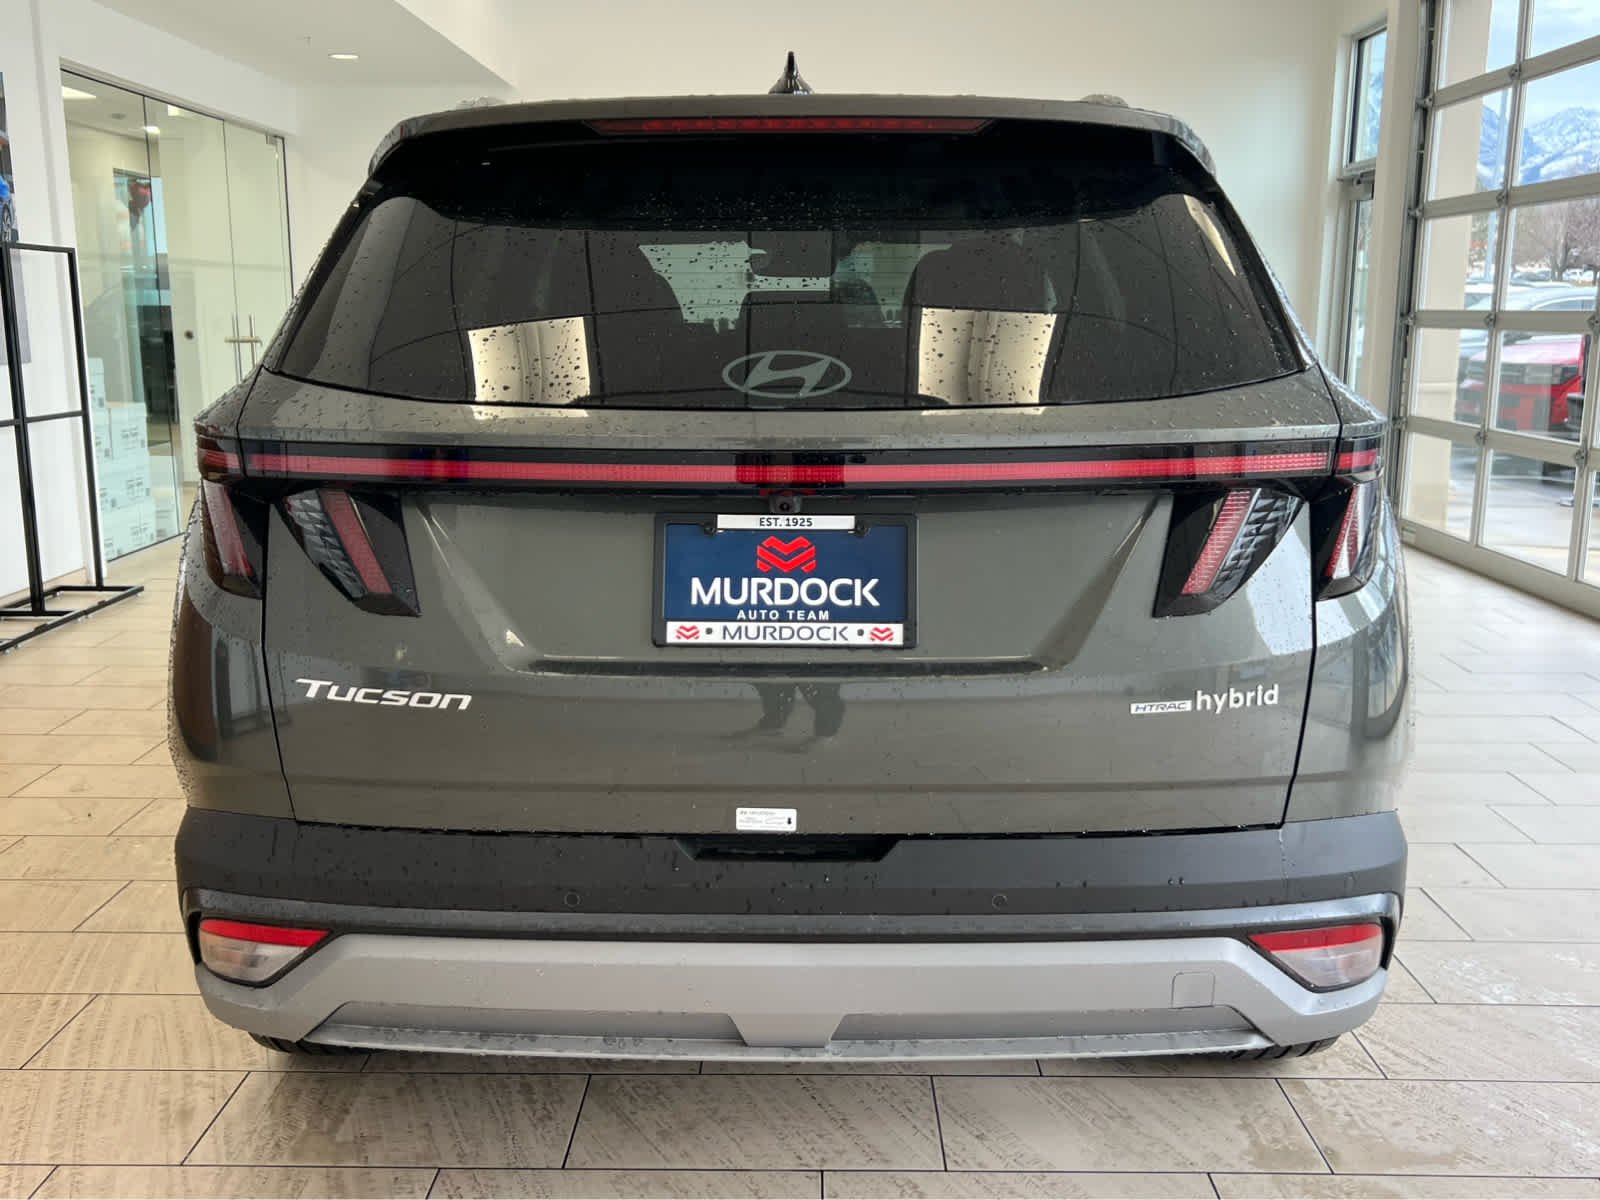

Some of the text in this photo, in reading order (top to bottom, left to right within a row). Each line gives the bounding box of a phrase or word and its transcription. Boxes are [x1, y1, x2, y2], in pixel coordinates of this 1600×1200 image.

[759, 517, 813, 528] EST. 1925
[690, 577, 880, 607] MURDOCK
[736, 610, 829, 621] AUTO TEAM
[722, 625, 848, 641] MURDOCK
[1135, 685, 1279, 714] HTRAC hybrid
